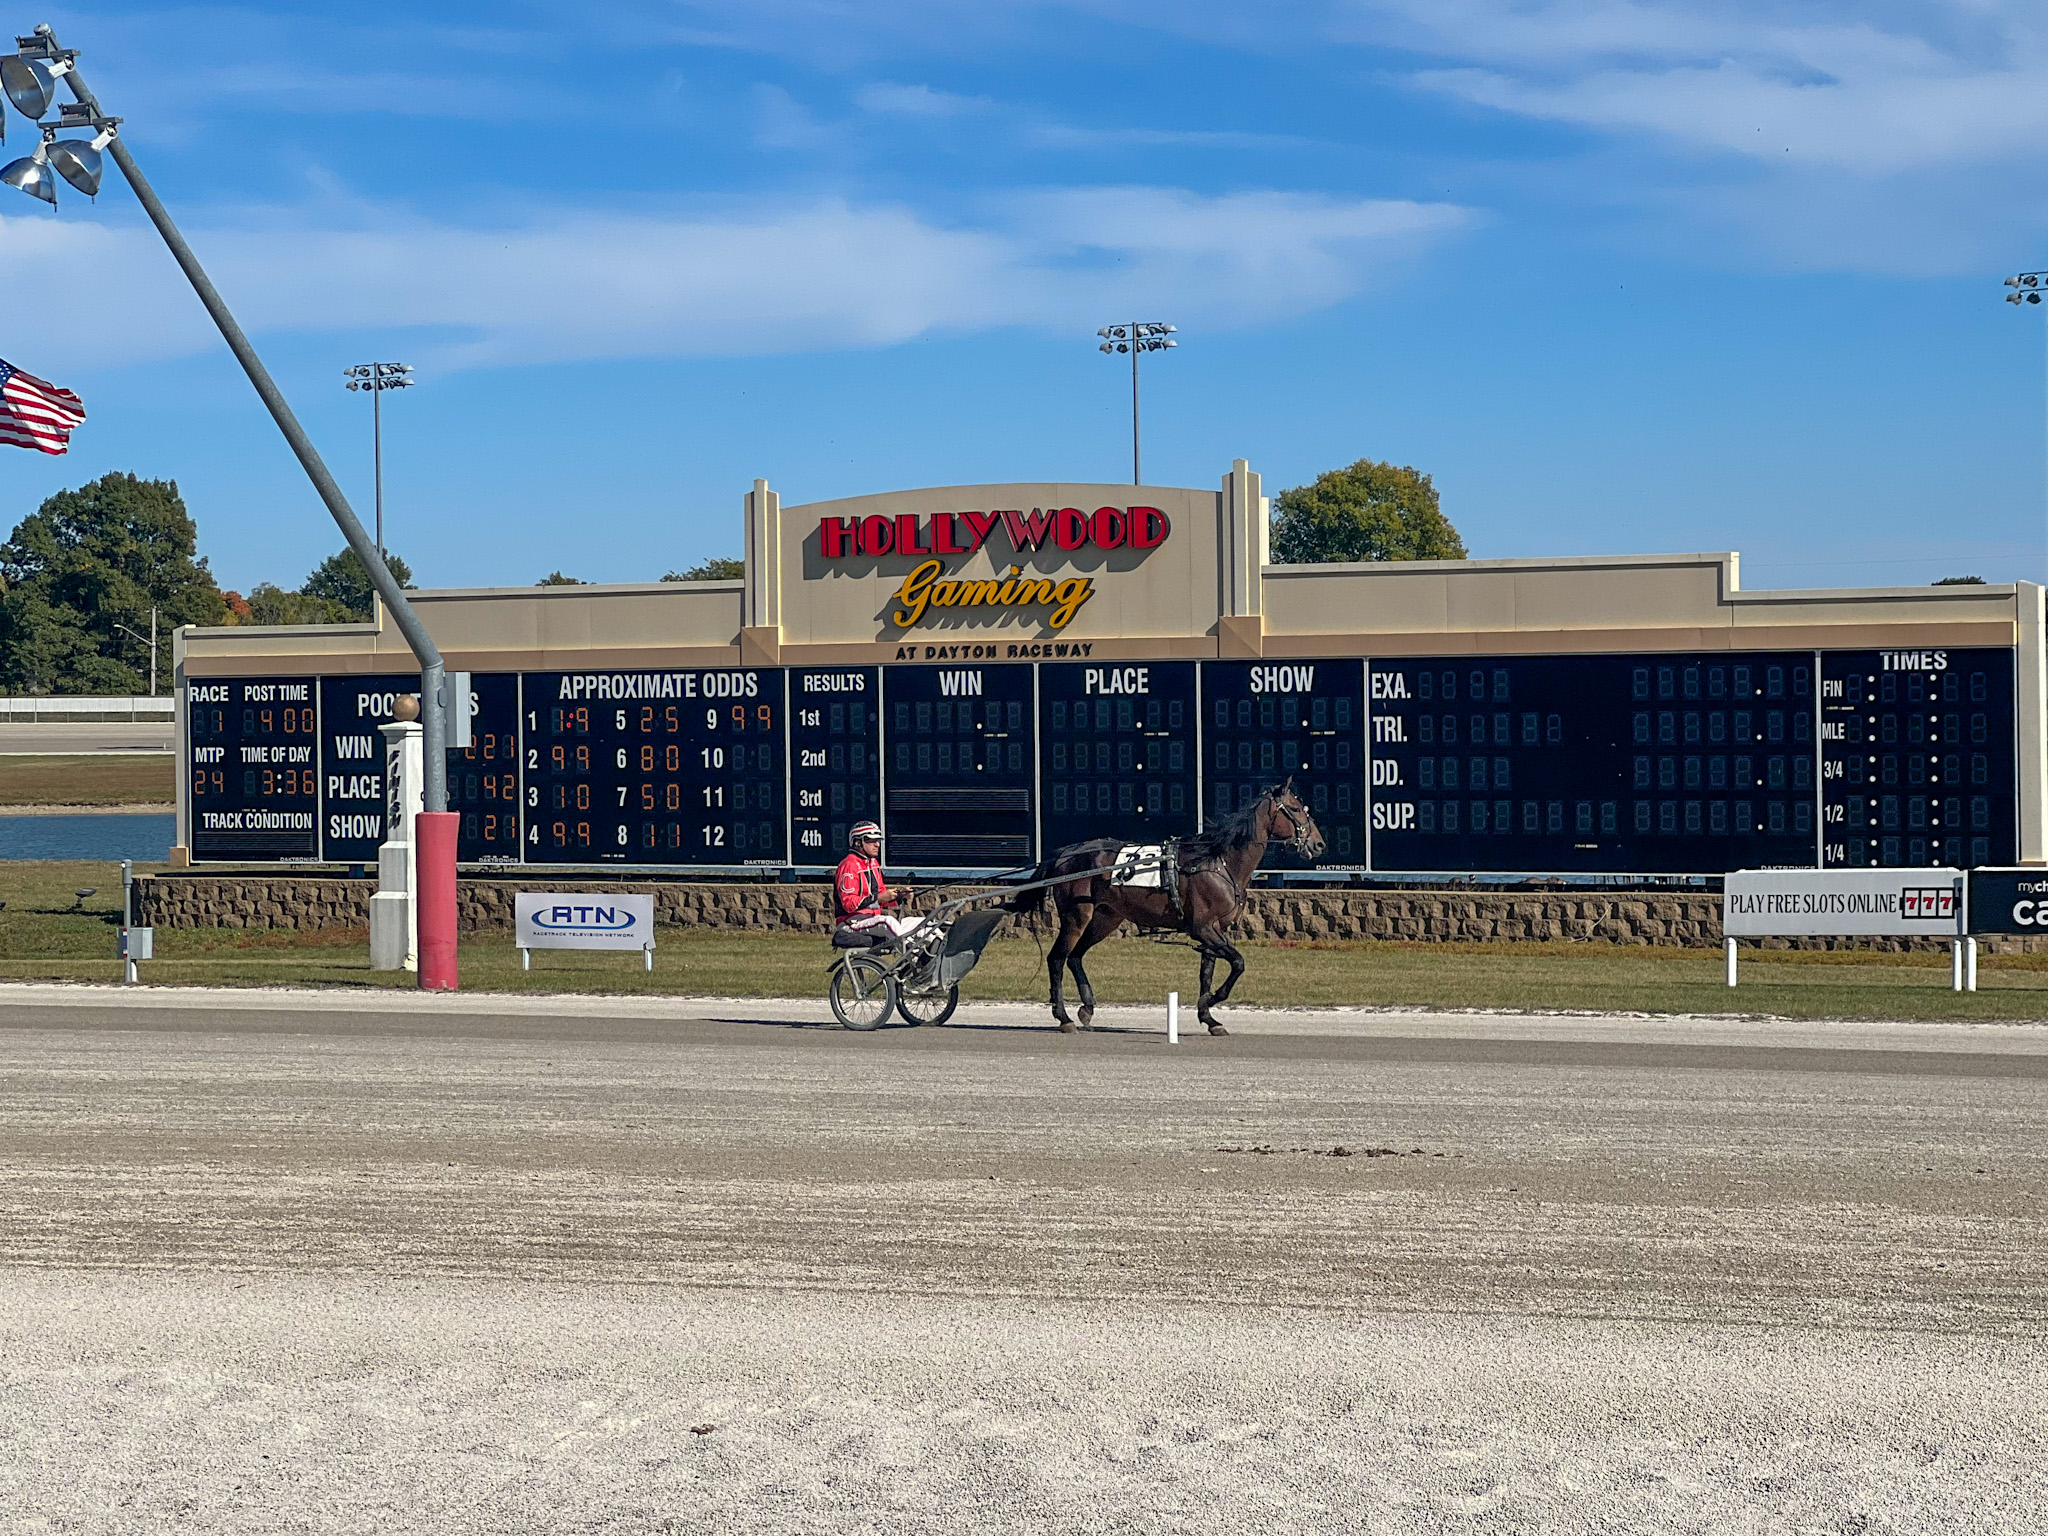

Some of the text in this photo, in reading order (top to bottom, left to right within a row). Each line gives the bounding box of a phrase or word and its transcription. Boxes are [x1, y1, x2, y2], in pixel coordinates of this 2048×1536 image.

[820, 506, 1171, 557] HOLLYWOOD
[892, 559, 1095, 629] Gaming
[895, 643, 1093, 661] AT DAYTON RACEWAY
[1880, 652, 1947, 670] TIMES
[560, 673, 757, 699] APPROXIMATE ODDS
[804, 674, 864, 691] RESULTS
[939, 671, 981, 695] WIN
[1086, 668, 1148, 694] PLACE
[1251, 666, 1314, 692] SHOW
[1372, 673, 1411, 698] EXA.
[1824, 681, 1842, 696] FIN
[189, 686, 229, 702] RACE
[245, 685, 308, 701] POST TIME
[529, 711, 535, 730] 1
[616, 710, 625, 729] 5
[707, 709, 716, 729] 9
[800, 709, 819, 725] 1st
[1373, 716, 1407, 742] TRI.
[1822, 723, 1845, 740] MLE
[196, 747, 224, 762] MTP
[241, 747, 311, 762] TIME OF DAY
[336, 736, 372, 758] WIN
[529, 749, 537, 768] 2
[617, 749, 626, 768] 6
[702, 748, 723, 768] 10
[802, 750, 825, 766] 2nd
[1373, 760, 1403, 785] DD.
[1825, 761, 1842, 779] 3/4
[329, 776, 380, 798] PLACE
[529, 787, 537, 806] 3
[618, 787, 626, 806] 7
[703, 787, 722, 806] 11
[800, 790, 821, 806] 3rd
[202, 812, 313, 830] TRACK CONDITION
[1373, 803, 1414, 829] SUP.
[1825, 805, 1843, 823] 1/2
[331, 815, 380, 838] SHOW
[529, 825, 538, 844] 4
[618, 825, 627, 845] 8
[703, 826, 723, 845] 12
[801, 830, 821, 846] 4th
[1824, 844, 1845, 862] 1/4
[1730, 894, 1765, 914] PLAY
[1767, 894, 1801, 914] FREE
[1802, 894, 1845, 914] SLOTS
[1847, 893, 1897, 913] ONLINE
[552, 906, 615, 924] RTN
